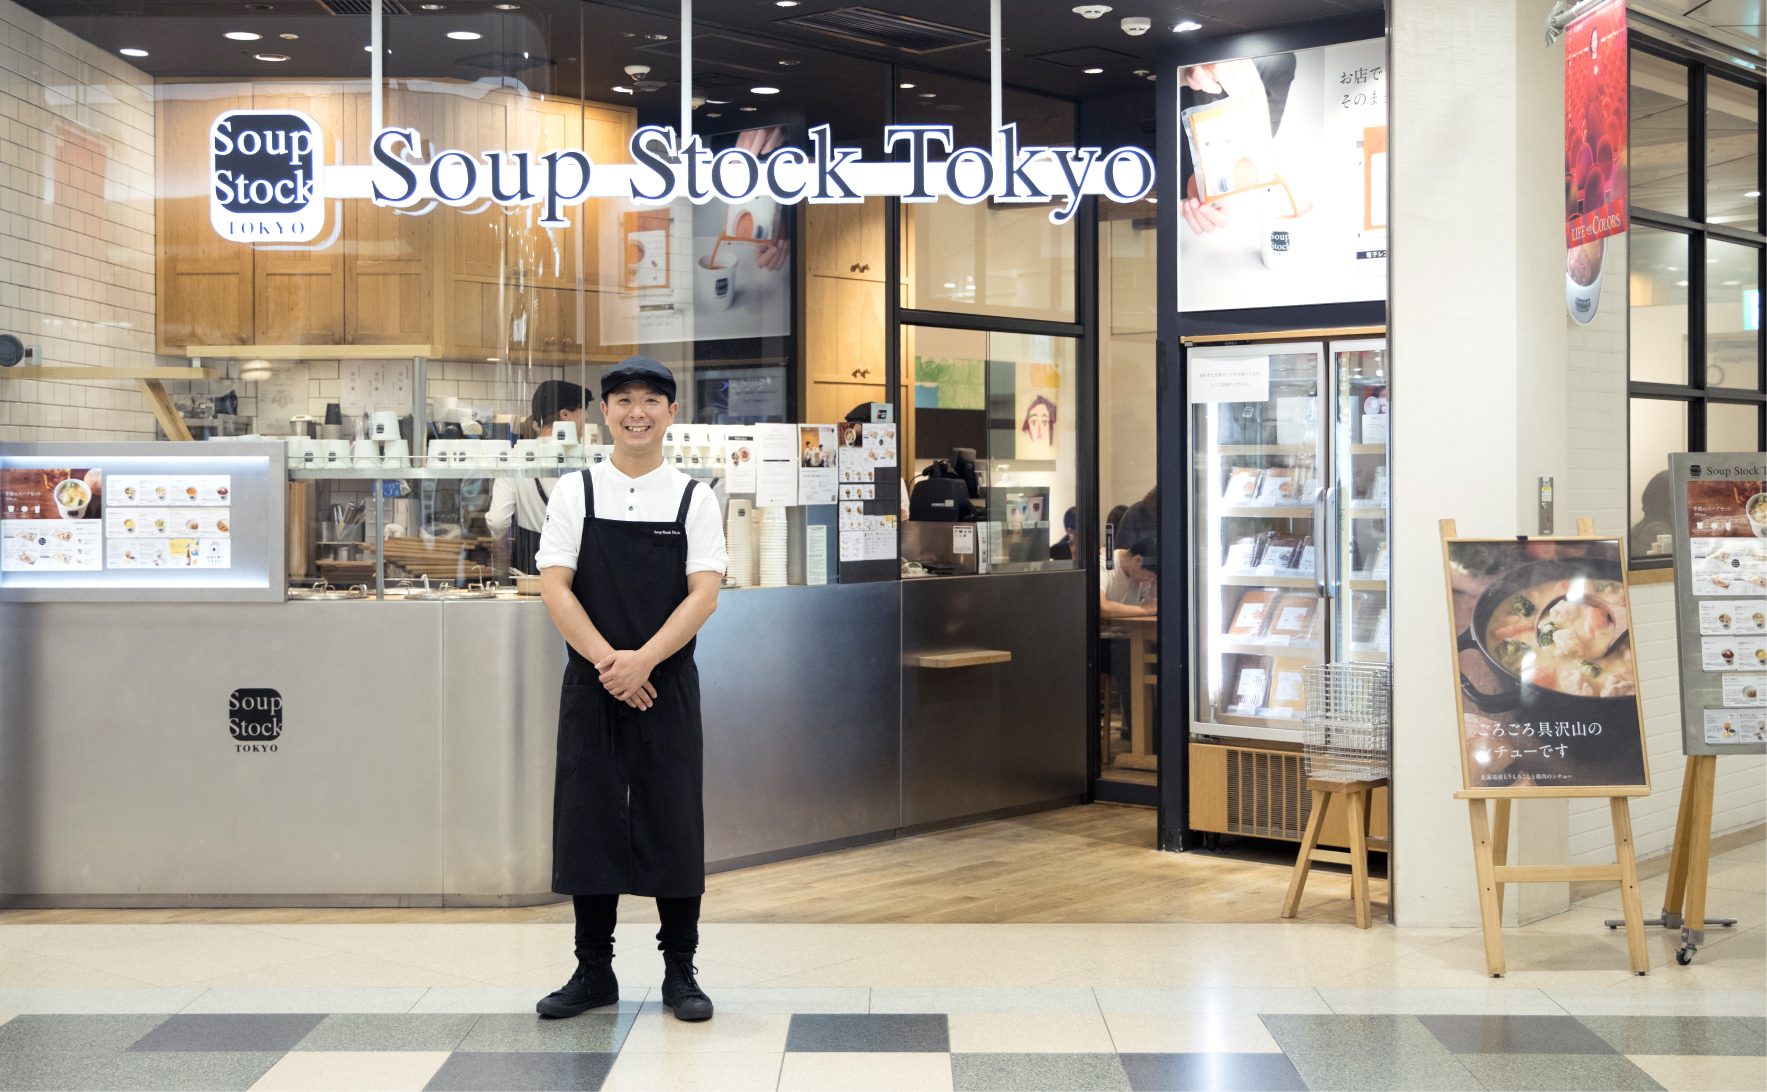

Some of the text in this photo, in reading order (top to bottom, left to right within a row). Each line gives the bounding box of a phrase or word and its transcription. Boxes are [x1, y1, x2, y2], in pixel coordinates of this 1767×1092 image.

[1339, 66, 1383, 85] お店で
[214, 120, 314, 165] Soup
[371, 123, 1156, 227] Soup Stock Tokyo
[214, 170, 314, 205] Stock
[226, 221, 305, 236] TOKYO
[1270, 231, 1290, 242] Soup
[1571, 225, 1585, 241] LIFE
[1592, 213, 1621, 235] COLORS
[1706, 466, 1731, 477] Soup
[1734, 466, 1759, 476] Stock
[229, 692, 282, 716] Soup
[229, 717, 282, 736] Stock
[1478, 721, 1602, 737] ごろごろ具沢山の
[235, 744, 278, 753] TOKYO
